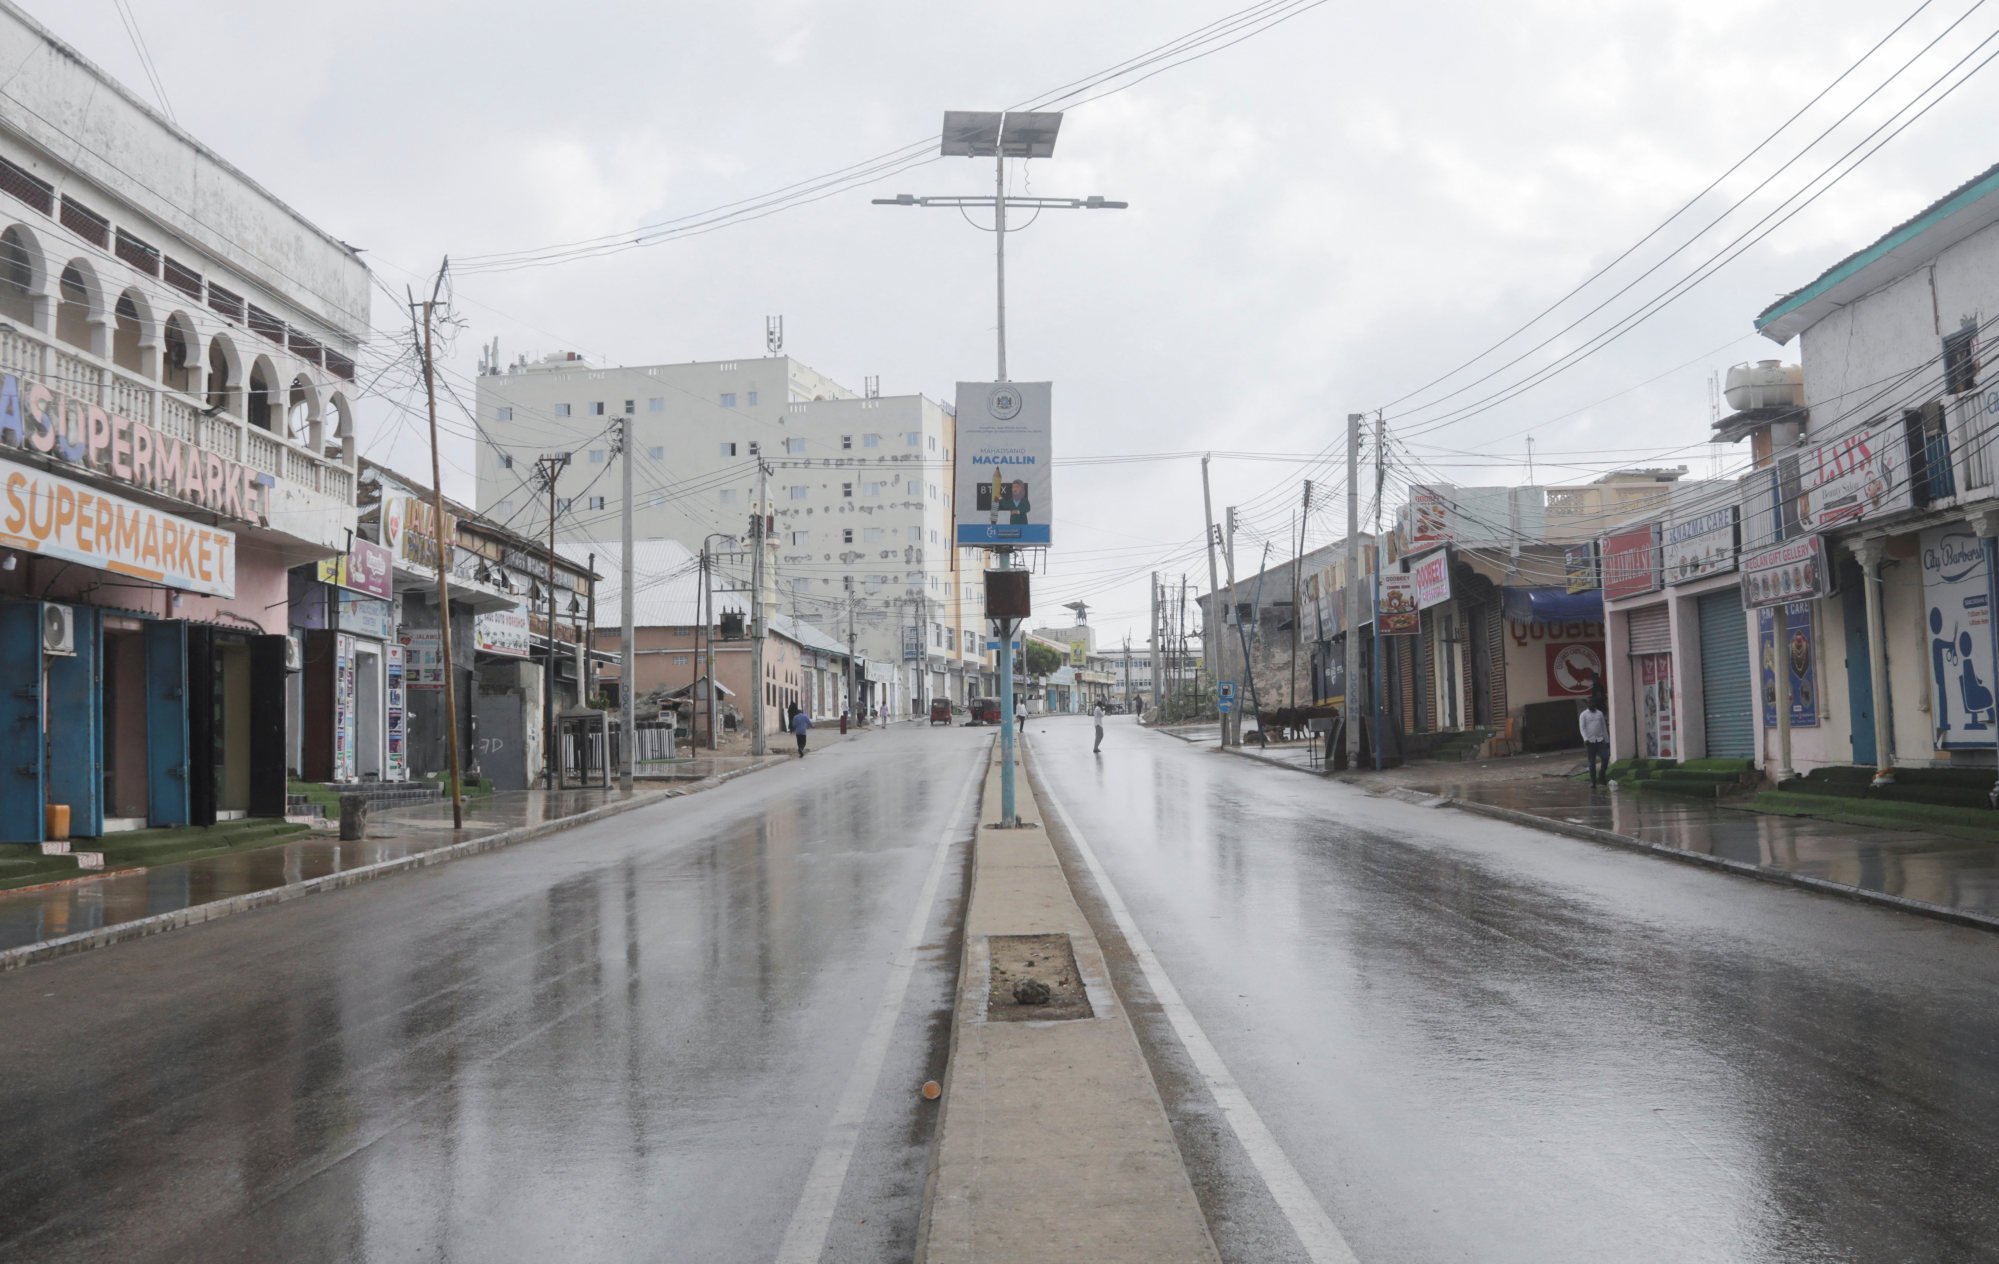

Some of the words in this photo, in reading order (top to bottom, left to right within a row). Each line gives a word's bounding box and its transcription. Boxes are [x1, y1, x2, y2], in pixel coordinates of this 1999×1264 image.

[28, 382, 276, 530] SUPERMARKET
[972, 455, 1036, 465] MACALLIN
[5, 470, 231, 585] SUPERMARKET
[1707, 508, 1729, 531] CARE
[1768, 550, 1782, 565] GIFT
[1782, 543, 1809, 561] GELLERY
[1923, 548, 1941, 572] City
[1790, 602, 1809, 615] CARE
